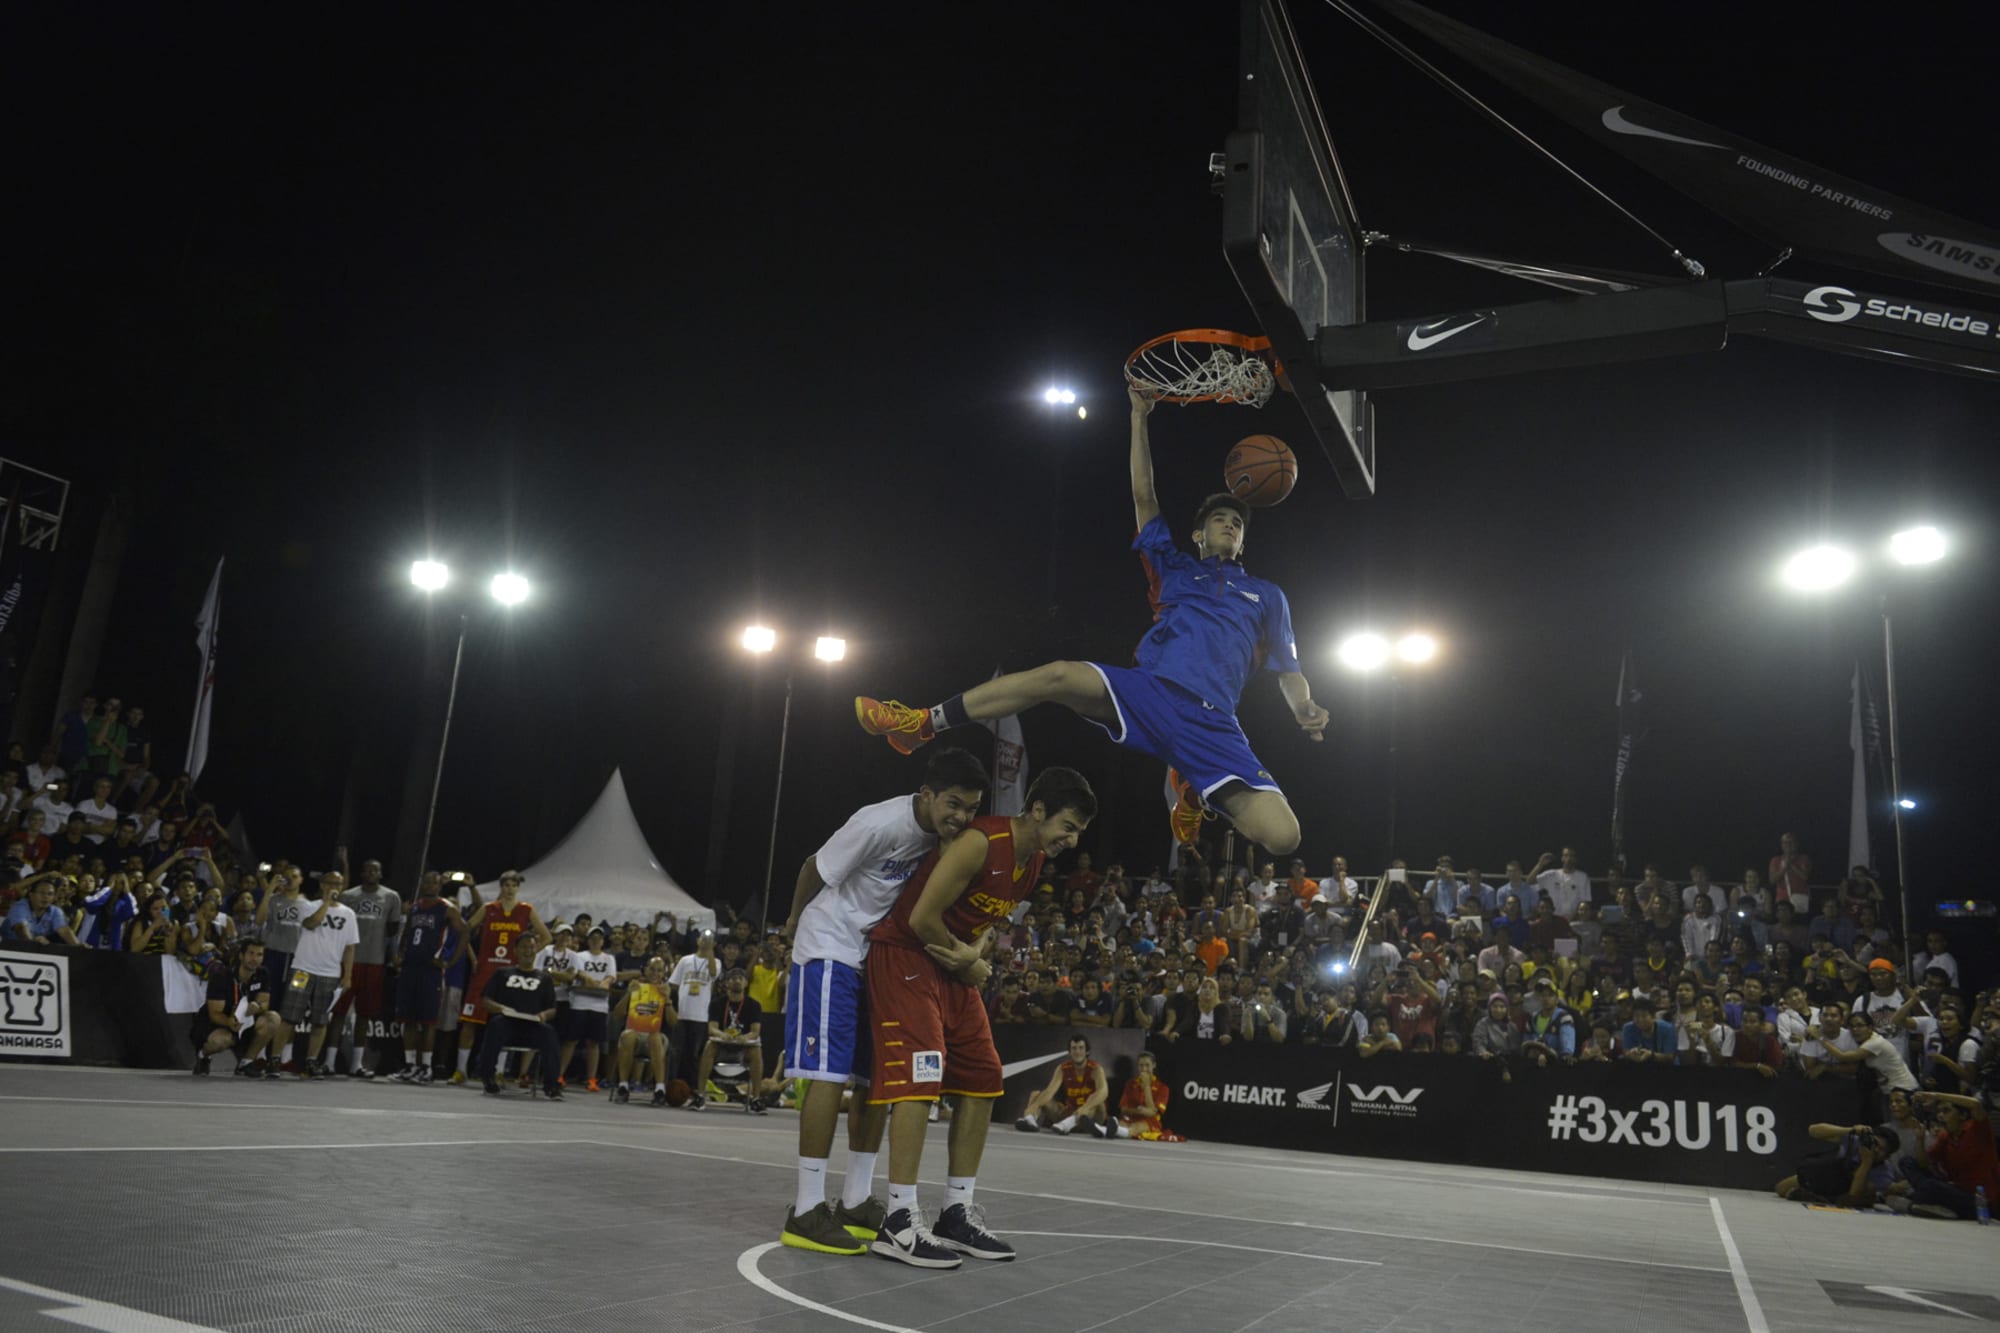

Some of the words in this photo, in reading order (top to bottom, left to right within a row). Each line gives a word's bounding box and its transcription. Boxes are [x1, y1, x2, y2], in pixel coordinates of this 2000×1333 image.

[1736, 154, 1810, 191] FOUNDING
[1810, 182, 1894, 222] PARTNERS
[1863, 298, 1990, 336] Schelde
[411, 928, 423, 945] 8
[1183, 1080, 1220, 1101] One
[1223, 1083, 1287, 1107] HEART.
[1296, 1102, 1332, 1111] HONDA
[1350, 1101, 1388, 1110] WAHANA
[1389, 1104, 1418, 1113] ARTHA
[1548, 1094, 1778, 1155] #3x3U18
